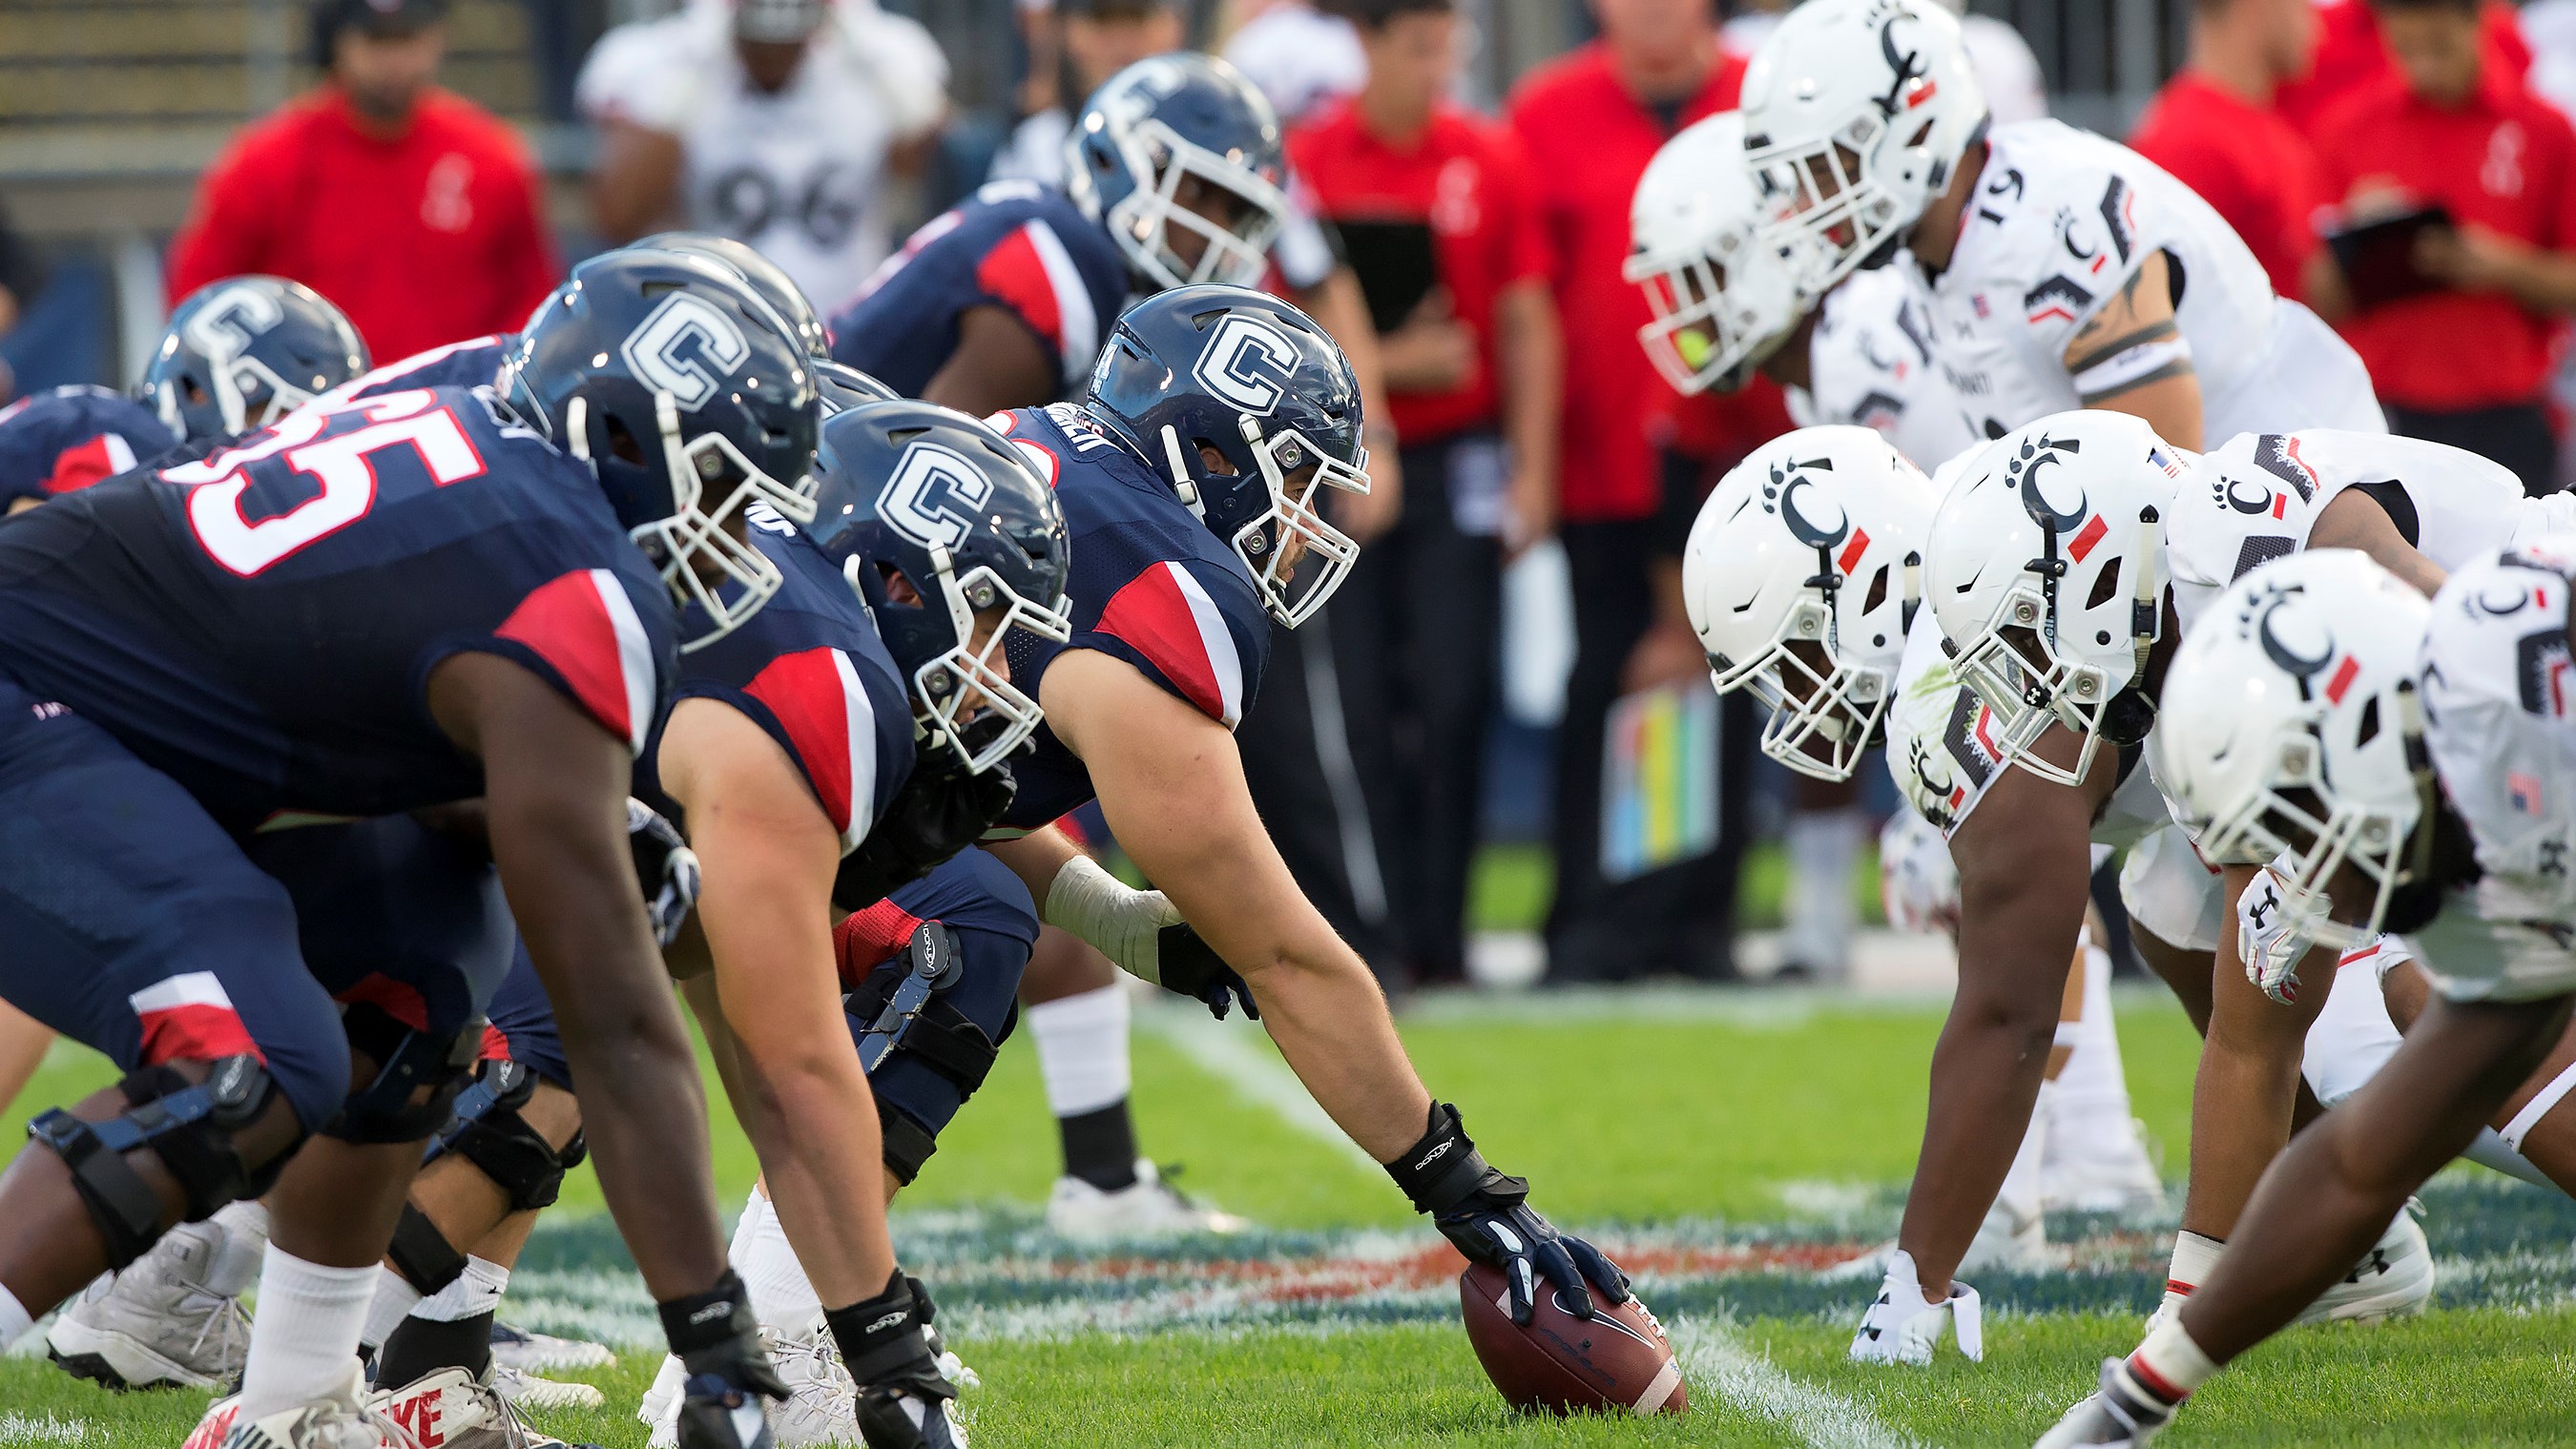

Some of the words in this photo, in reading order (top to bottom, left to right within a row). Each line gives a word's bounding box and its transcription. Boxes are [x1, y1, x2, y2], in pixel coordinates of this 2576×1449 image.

[1978, 169, 2025, 226] 19
[621, 292, 750, 411] C
[1192, 315, 1302, 416] C
[875, 442, 994, 553] C
